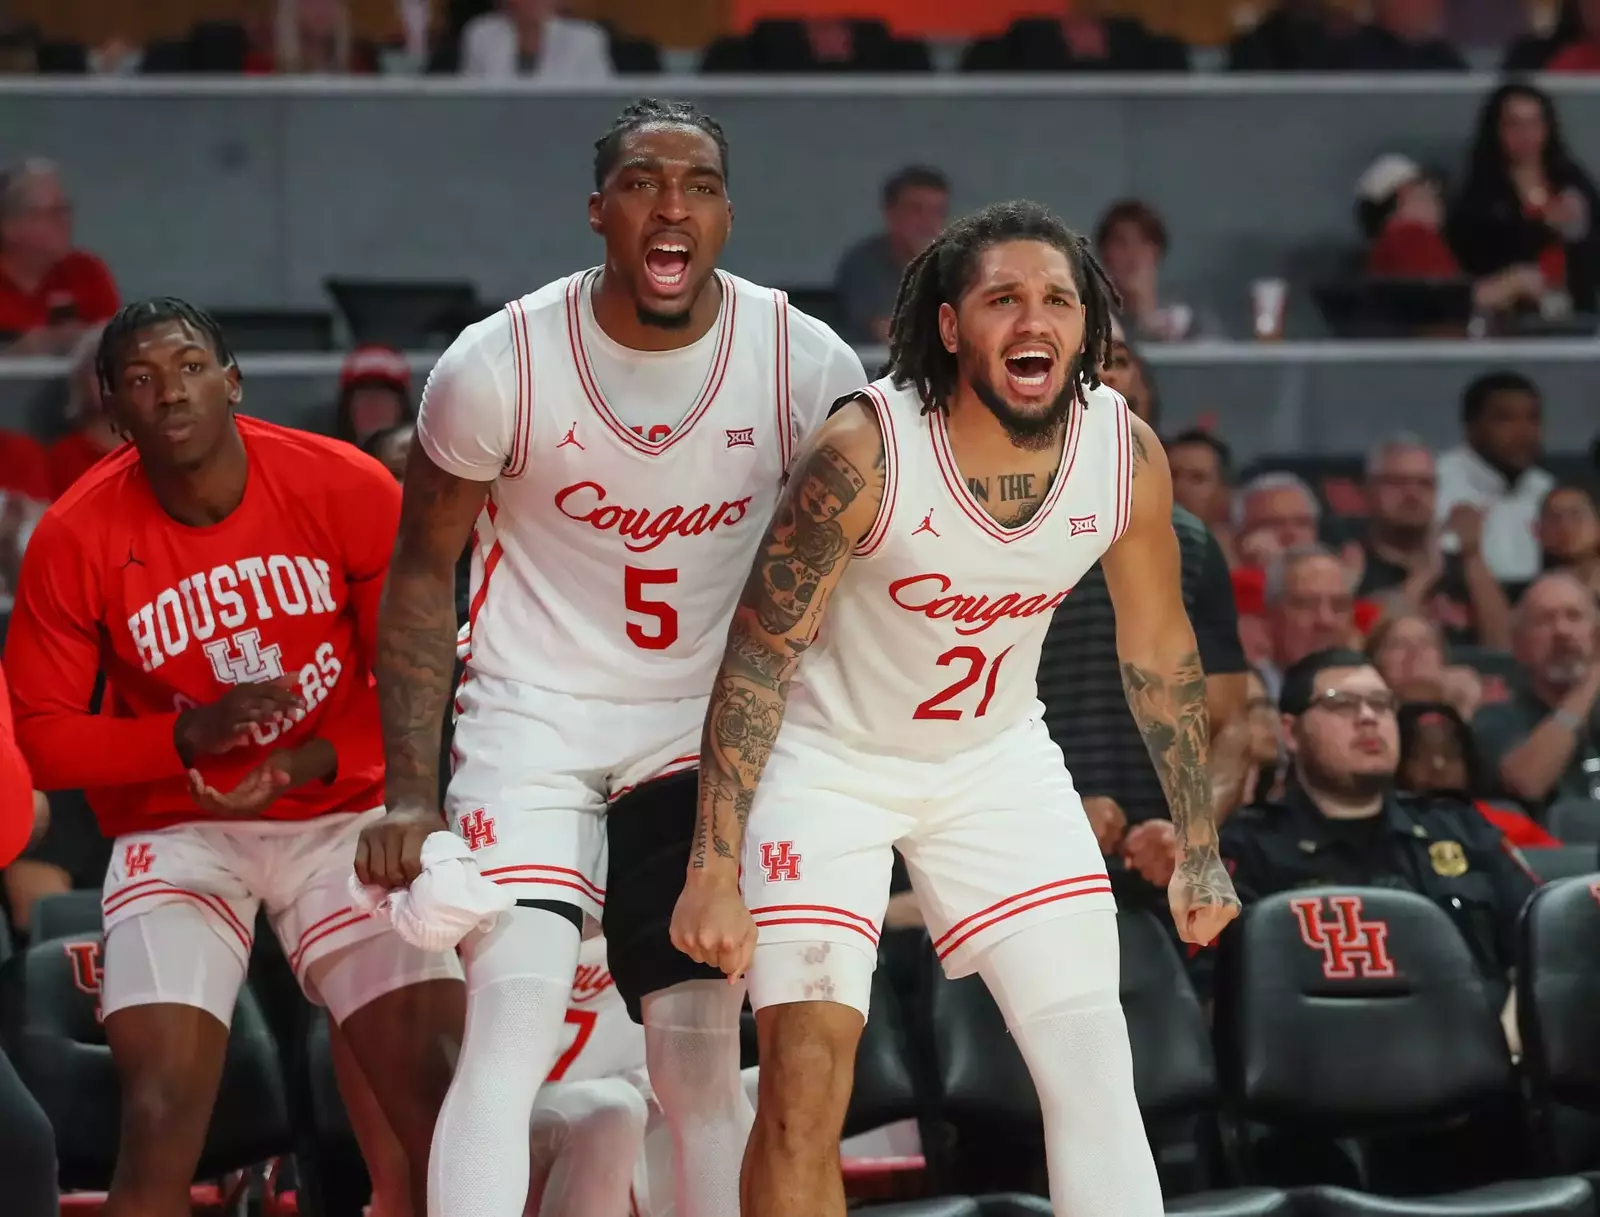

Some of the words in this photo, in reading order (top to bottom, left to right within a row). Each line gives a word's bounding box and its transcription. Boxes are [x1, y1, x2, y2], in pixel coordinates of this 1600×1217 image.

[554, 481, 752, 553] Cougars
[997, 473, 1037, 502] THE
[127, 554, 337, 673] HOUSTON
[624, 564, 678, 650] 5
[912, 644, 1016, 720] 21
[1290, 896, 1395, 979] UH
[544, 1008, 598, 1083] 7
